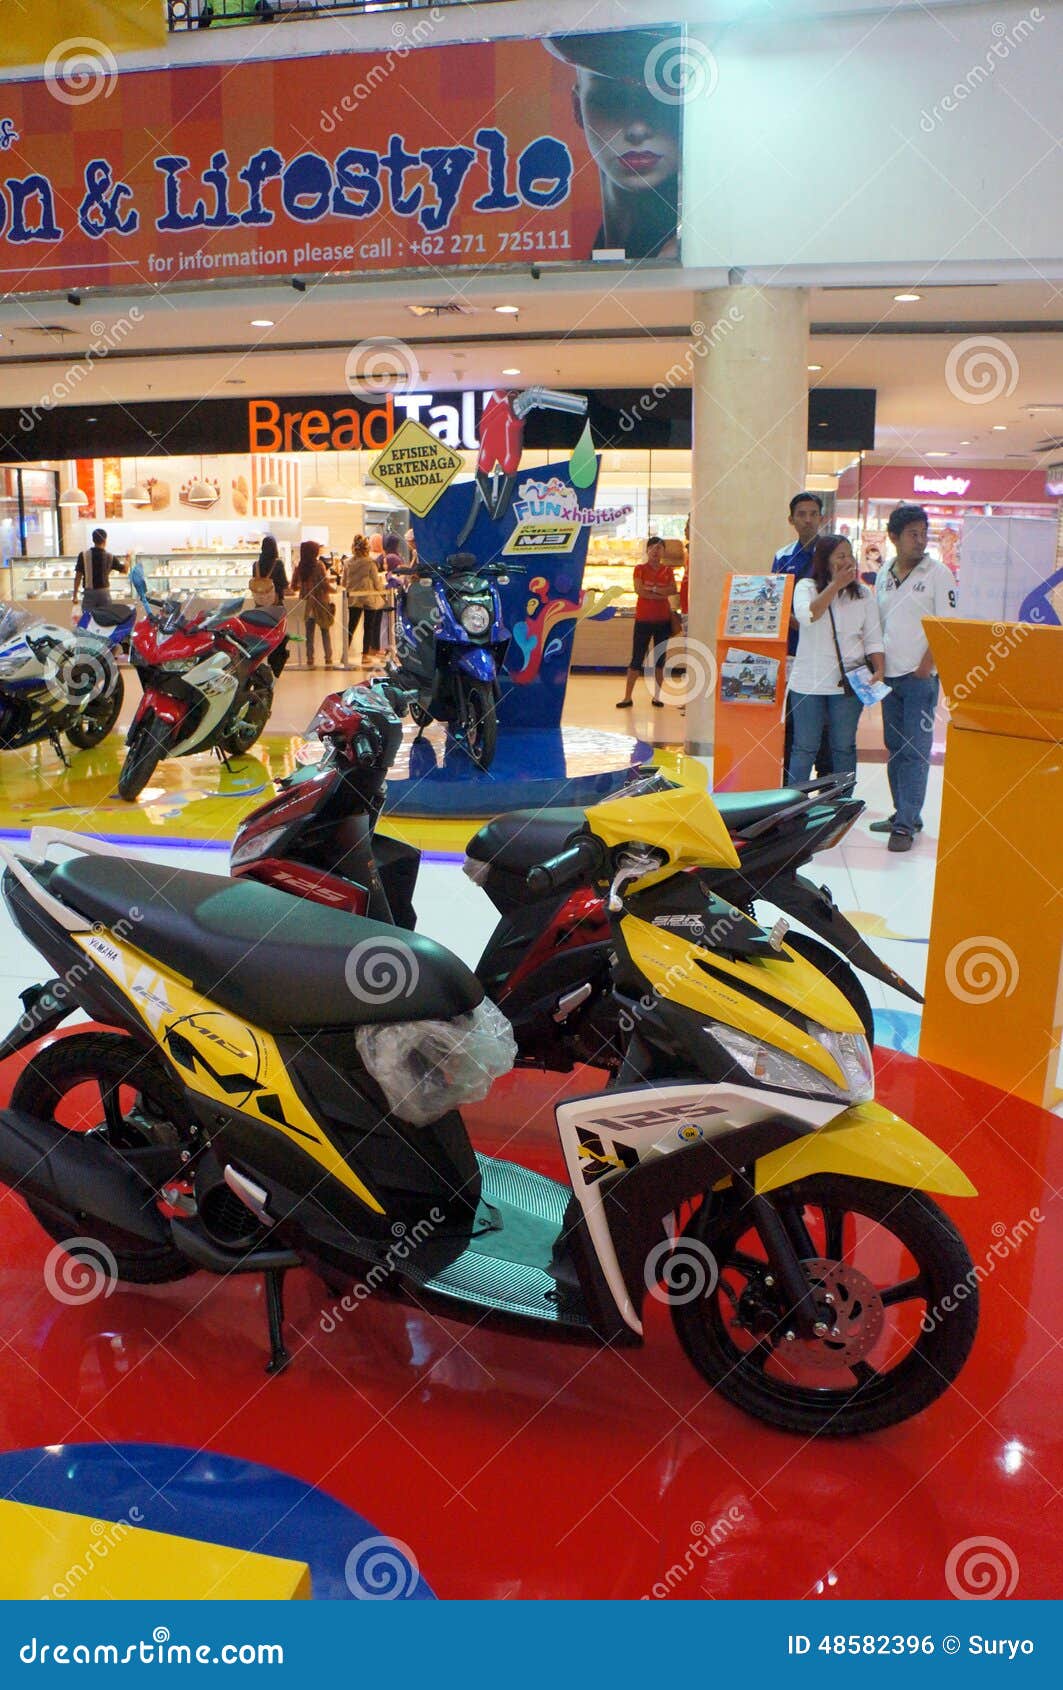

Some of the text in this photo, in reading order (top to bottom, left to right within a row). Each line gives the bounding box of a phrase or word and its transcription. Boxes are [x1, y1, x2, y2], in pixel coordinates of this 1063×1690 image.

[0, 127, 574, 244] n & Lifestyle
[147, 253, 174, 273] for
[179, 246, 288, 271] information
[293, 242, 355, 267] please
[359, 238, 392, 259] call
[409, 236, 445, 256] +62
[450, 233, 487, 253] 271
[497, 229, 572, 252] 725111
[248, 390, 494, 453] BreadTal
[378, 457, 456, 477] BERTENAGA
[391, 445, 438, 461] EFISIEN
[394, 473, 443, 488] HANDAL
[271, 870, 348, 902] 125
[88, 937, 118, 961] YAMAHA
[586, 1102, 730, 1132] 125
